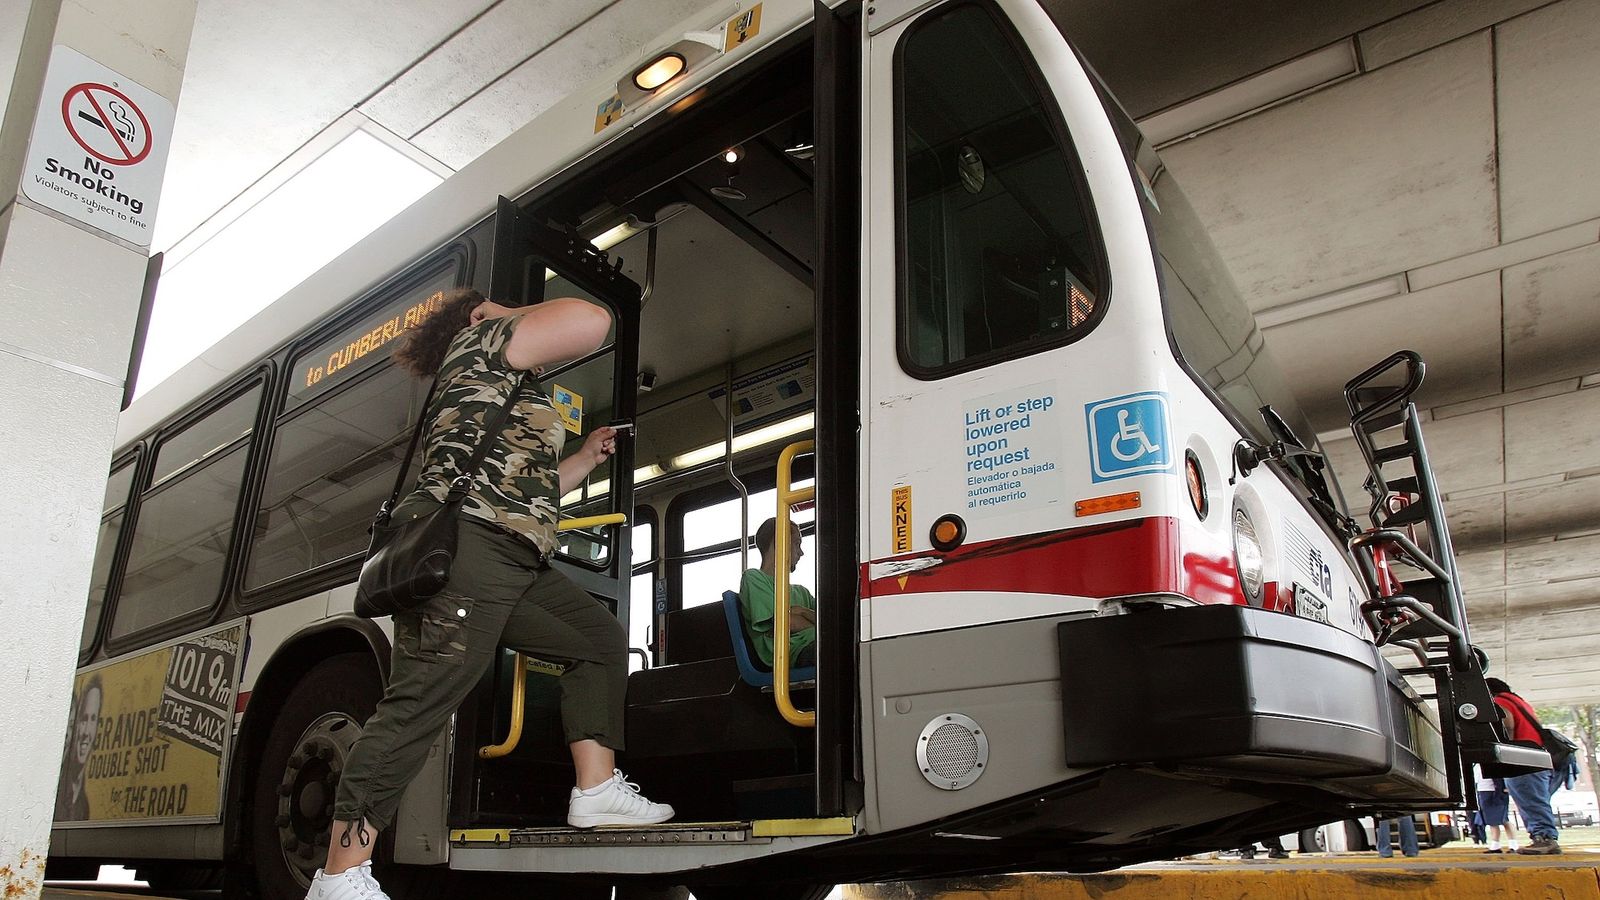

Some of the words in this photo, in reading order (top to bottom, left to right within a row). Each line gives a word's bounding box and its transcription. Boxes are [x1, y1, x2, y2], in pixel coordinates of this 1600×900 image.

[83, 156, 115, 181] No
[34, 174, 79, 200] Violators
[81, 196, 115, 217] subject
[117, 210, 127, 221] to
[129, 215, 147, 229] fine
[44, 157, 144, 215] Smoking
[305, 367, 323, 387] to
[326, 290, 445, 376] CUMBERLAND
[965, 407, 991, 426] Lift
[995, 405, 1013, 419] or
[1017, 395, 1054, 415] step
[965, 414, 1031, 441] lowered
[966, 437, 1008, 459] upon
[967, 447, 1030, 472] request
[967, 470, 1010, 486] Elevador
[1011, 469, 1019, 477] o
[1021, 461, 1055, 476] bajada
[967, 480, 1021, 497] automática
[968, 499, 977, 508] al
[979, 490, 1027, 508] requerirlo
[94, 707, 158, 751] GRANDE
[164, 699, 191, 727] THE
[193, 712, 226, 742] MIX
[88, 750, 130, 780] DOUBLE
[135, 743, 171, 774] SHOT
[111, 787, 123, 803] for
[123, 786, 148, 813] THE
[148, 783, 188, 816] ROAD
